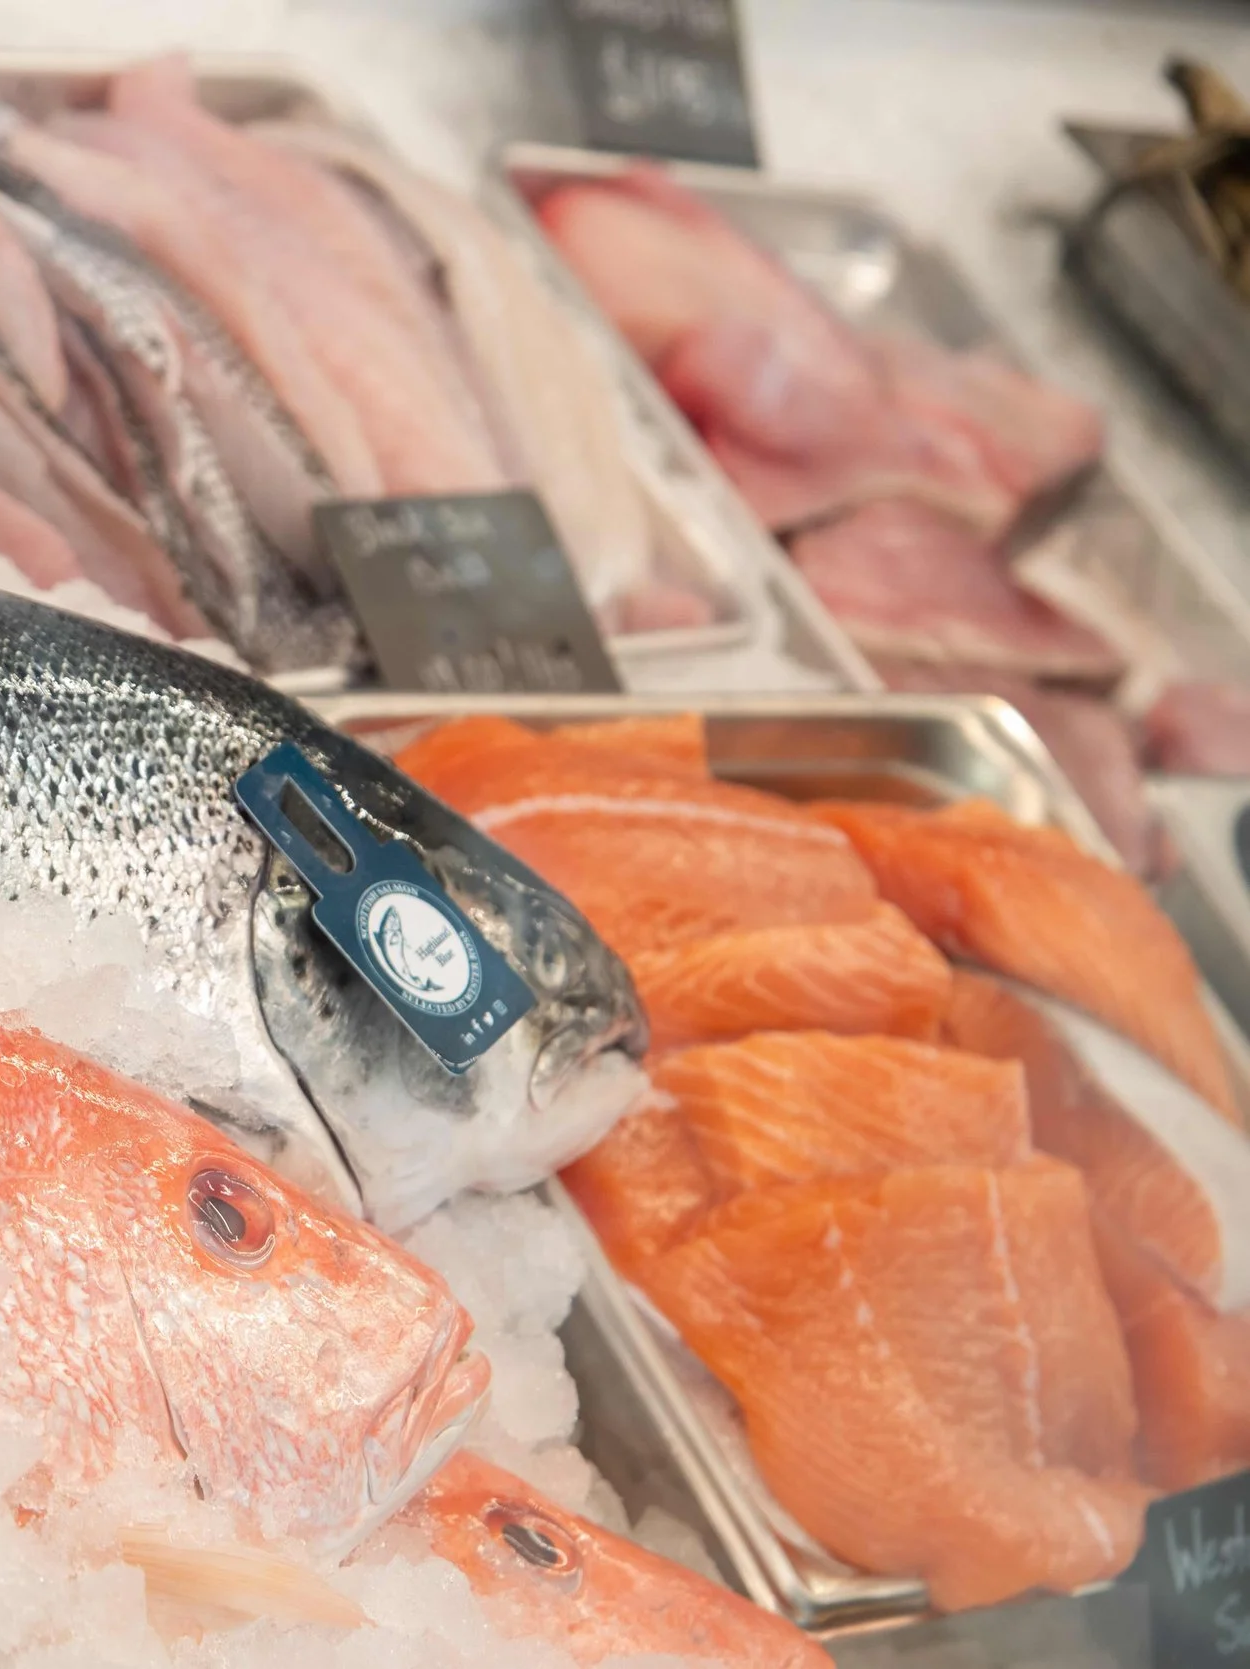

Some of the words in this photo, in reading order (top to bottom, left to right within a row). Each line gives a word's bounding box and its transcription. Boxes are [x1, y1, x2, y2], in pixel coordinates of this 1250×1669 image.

[359, 889, 378, 940] SCOTTISH
[377, 882, 419, 897] SALMON
[415, 926, 452, 962] Highland
[401, 990, 456, 1014] SELECTED
